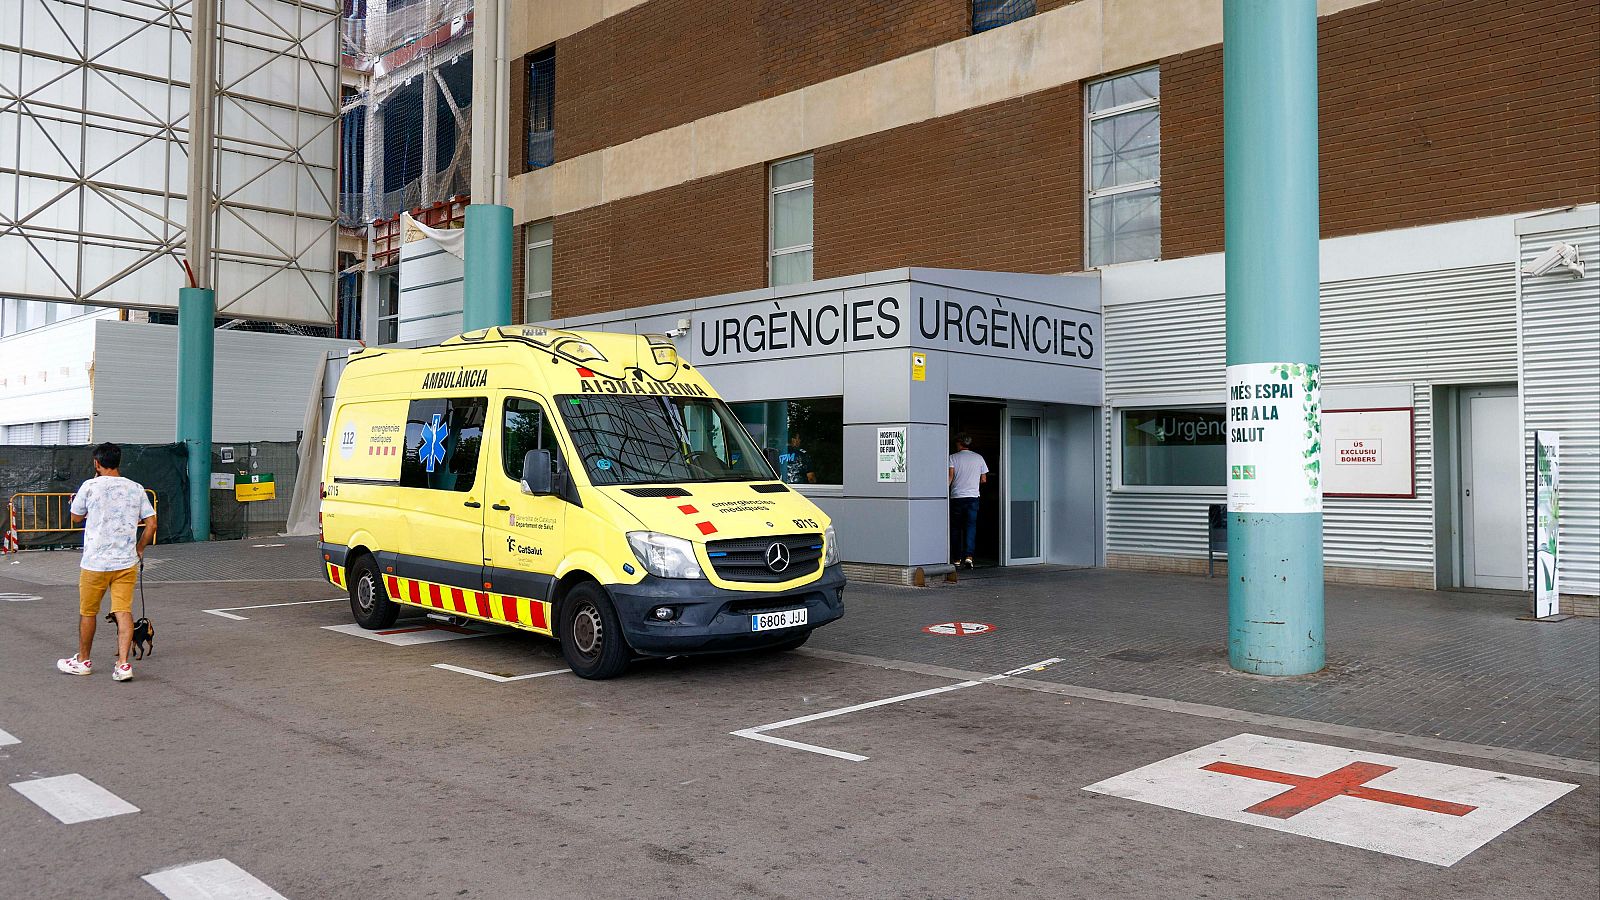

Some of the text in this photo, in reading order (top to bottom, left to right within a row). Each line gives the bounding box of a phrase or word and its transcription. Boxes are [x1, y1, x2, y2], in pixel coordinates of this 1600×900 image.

[701, 297, 900, 356] URGÈNCIES
[919, 297, 1094, 360] URGÈNCIES
[422, 366, 488, 389] AMBULÀNCIA
[1231, 381, 1293, 400] MÉS ESPAI
[1231, 406, 1279, 421] PER A LA
[342, 432, 354, 444] 112
[1231, 427, 1264, 443] SALUT
[792, 519, 818, 528] 8715
[518, 545, 542, 556] CatSalut
[760, 610, 805, 628] 6806 JJJ
